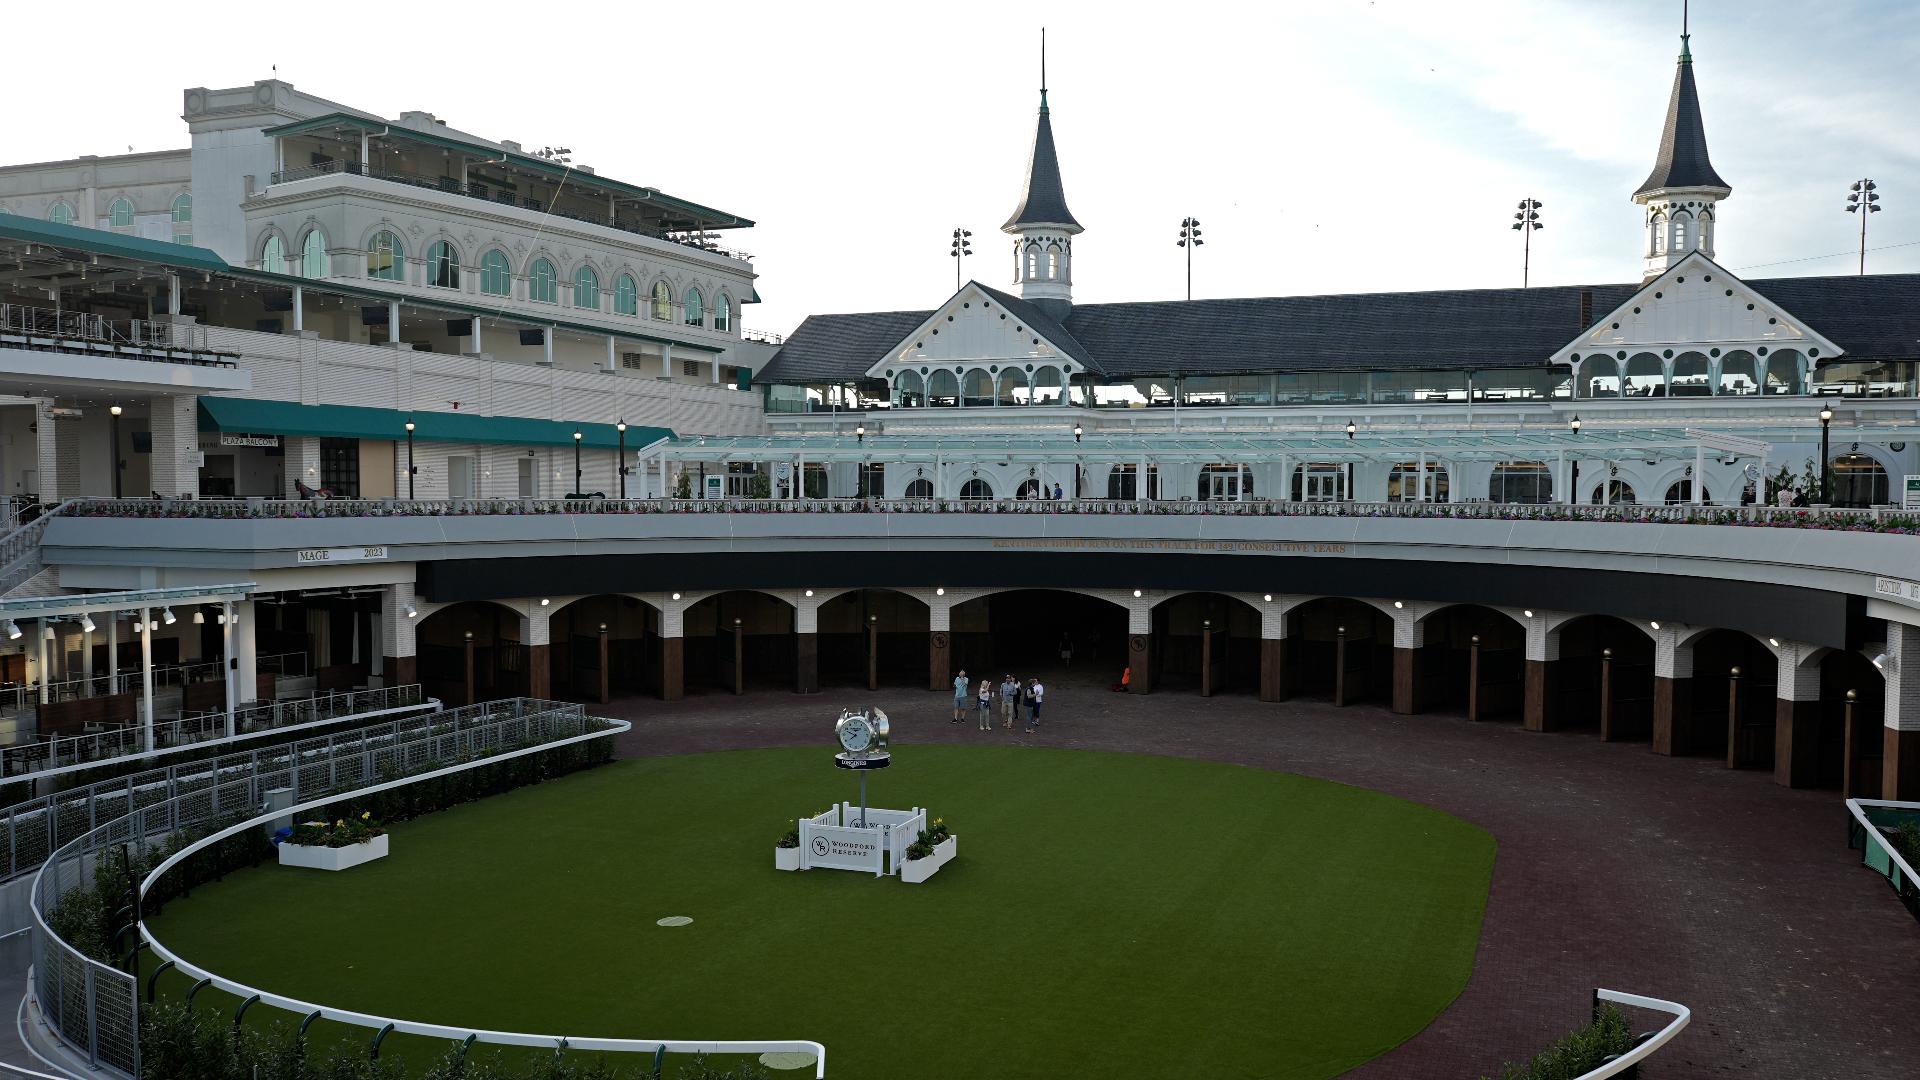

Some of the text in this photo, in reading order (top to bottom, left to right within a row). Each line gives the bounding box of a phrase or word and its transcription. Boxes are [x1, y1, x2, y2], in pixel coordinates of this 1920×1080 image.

[1112, 540, 1127, 548] ON
[1130, 540, 1153, 548] THIS
[1158, 540, 1192, 549] TRACK
[1194, 541, 1216, 550] FOR
[1238, 542, 1310, 552] CONSECUTIVE
[1313, 544, 1346, 553] YEARS
[300, 548, 382, 560] MAGE 2023
[832, 840, 876, 850] WOODFORD
[832, 848, 868, 856] RESERVE
